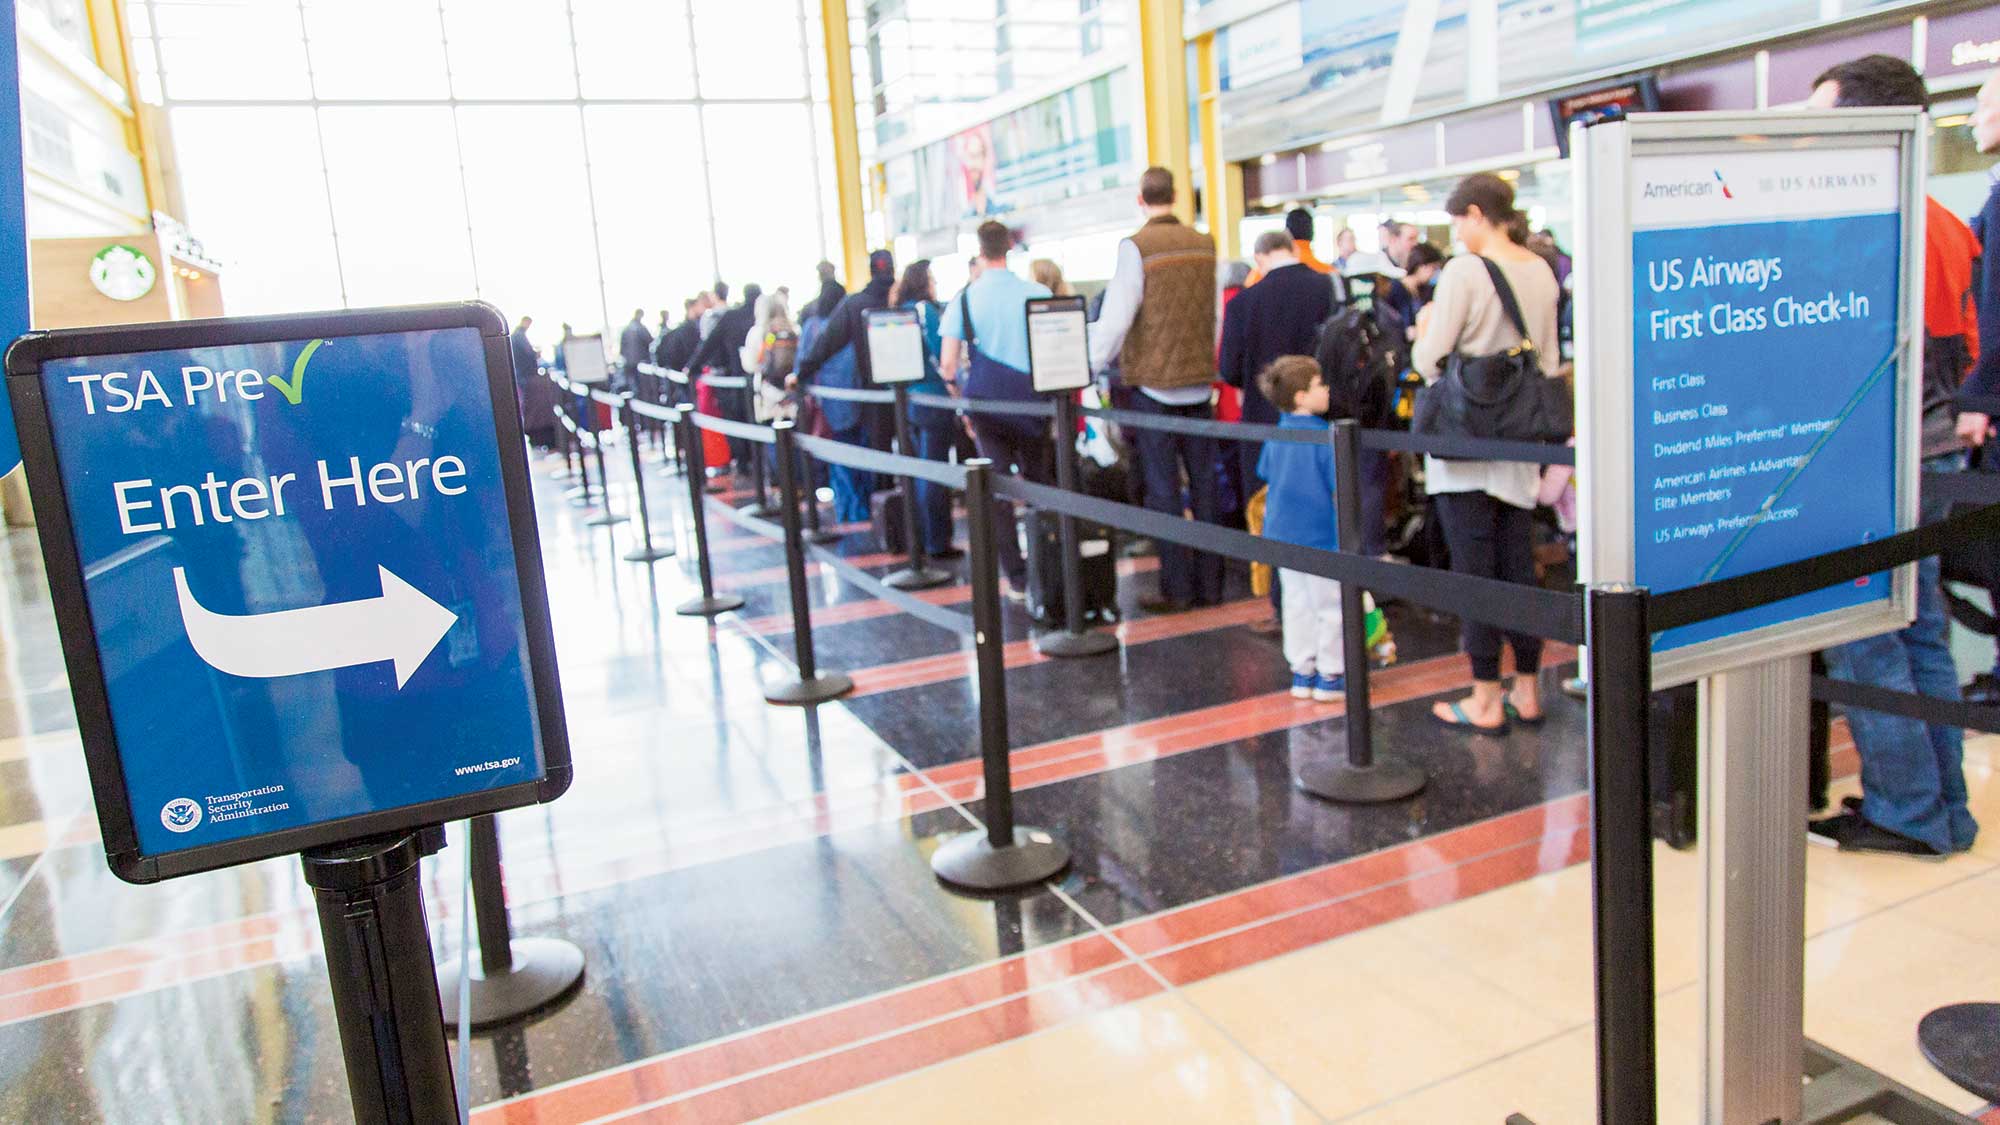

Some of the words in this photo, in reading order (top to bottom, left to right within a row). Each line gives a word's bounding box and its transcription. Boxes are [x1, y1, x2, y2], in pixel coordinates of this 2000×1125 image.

[1644, 180, 1713, 198] American
[1780, 177, 1802, 191] US
[1808, 173, 1878, 188] AIRWAYS
[1649, 258, 1684, 292] US
[1690, 256, 1782, 292] Airways
[1650, 309, 1704, 341] First
[1709, 303, 1767, 335] Class
[1773, 291, 1870, 328] Check-In
[67, 370, 173, 415] TSA
[181, 366, 265, 406] Pre
[1652, 377, 1677, 391] First
[1680, 373, 1706, 388] Class
[1653, 408, 1699, 425] Business
[1702, 403, 1728, 417] Class
[1654, 438, 1702, 458] Dividend
[1705, 435, 1733, 449] Miles
[1655, 471, 1706, 489] American
[1709, 464, 1746, 480] Airlines
[113, 470, 296, 535] Enter
[317, 455, 468, 510] Here
[1655, 495, 1678, 511] Elite
[1681, 488, 1731, 507] Members
[1656, 528, 1670, 543] US
[1673, 522, 1715, 540] Airways
[455, 756, 520, 776] www.tsa.gov
[205, 784, 285, 805] Transportation
[208, 800, 253, 815] Security
[210, 802, 290, 824] Administration
